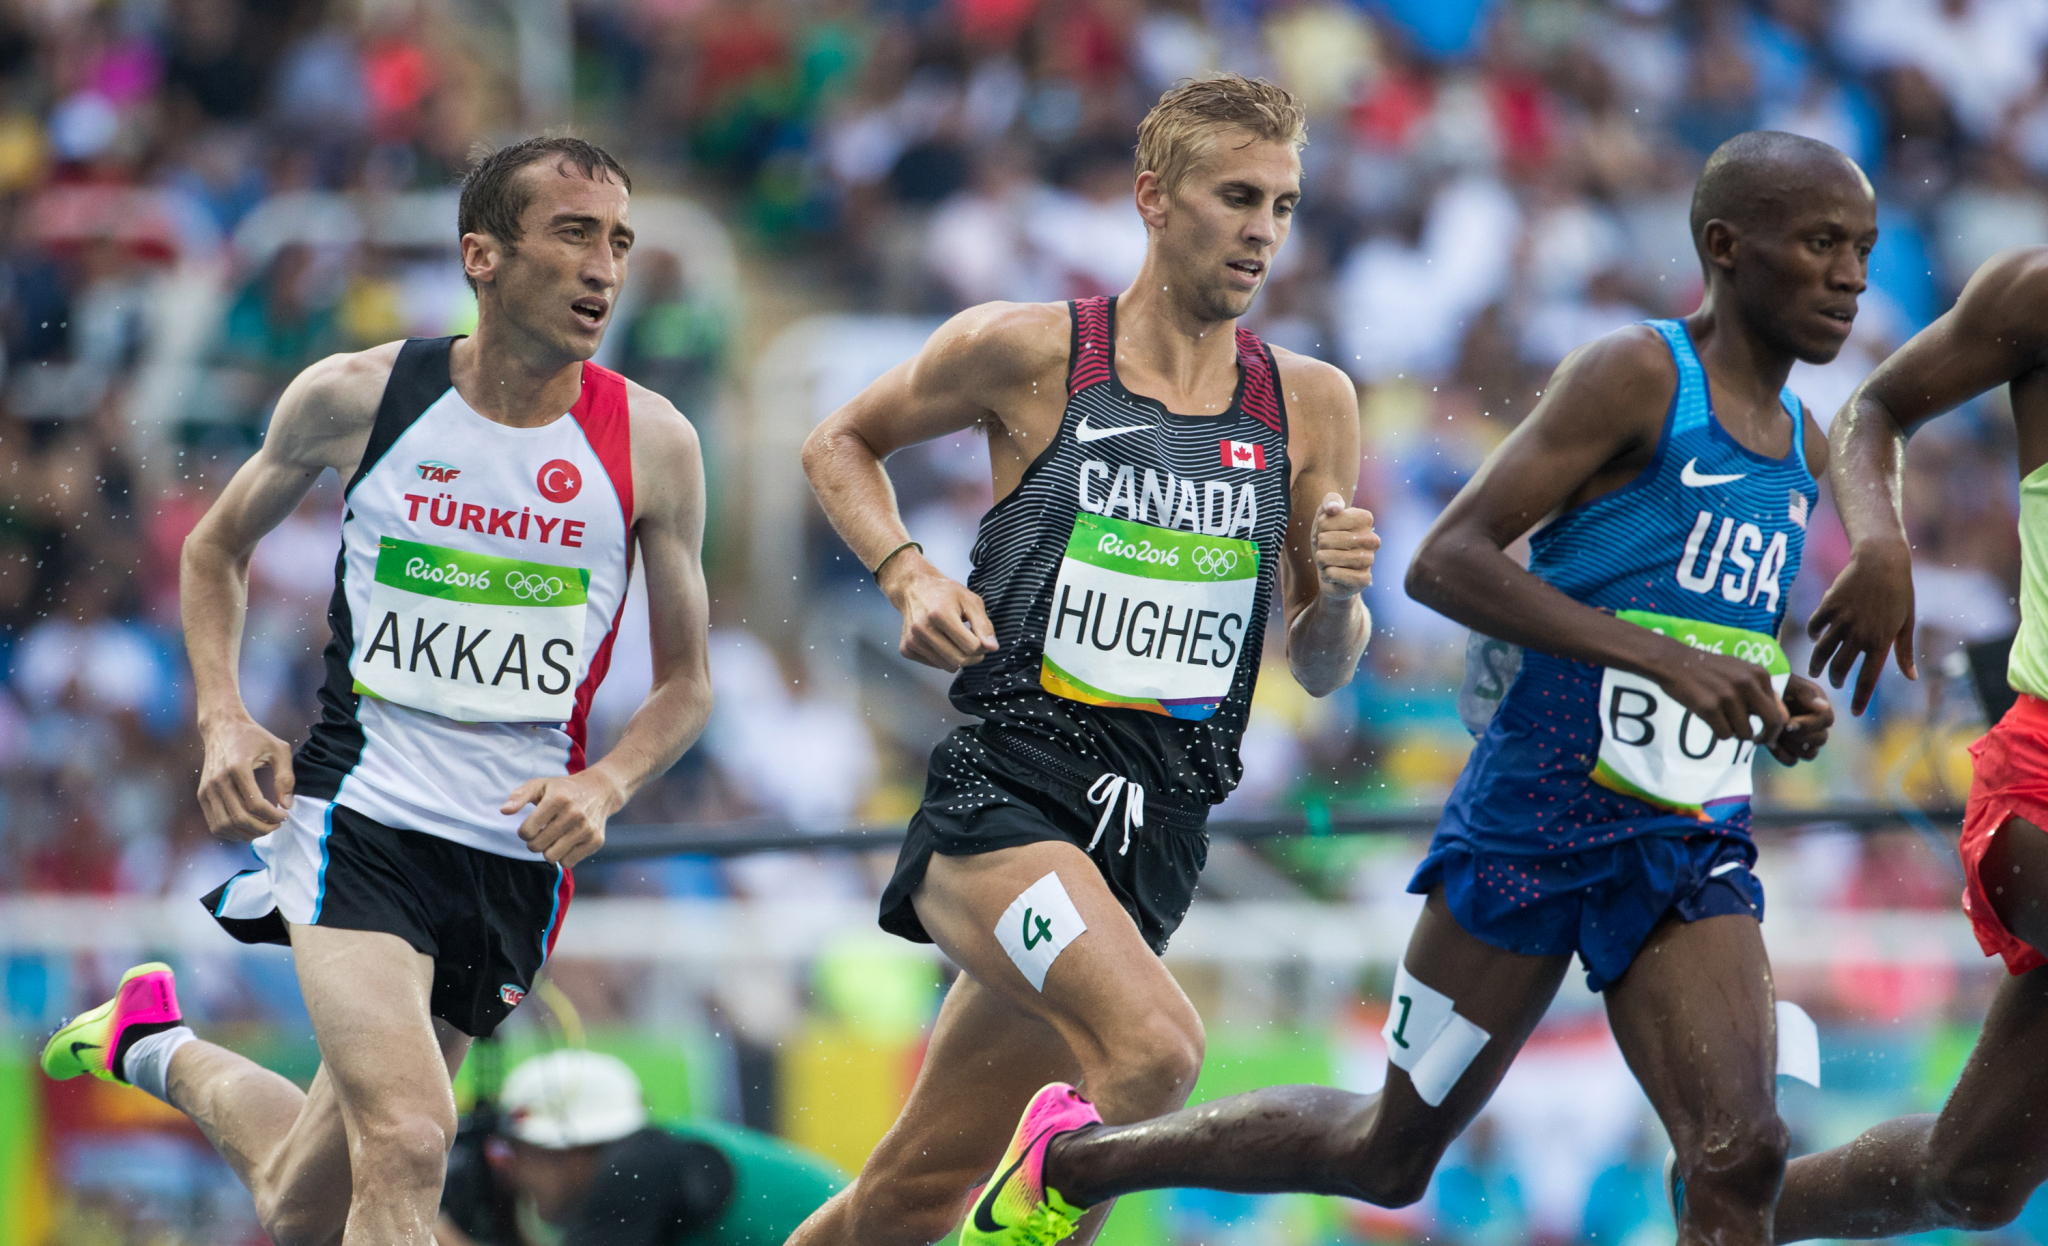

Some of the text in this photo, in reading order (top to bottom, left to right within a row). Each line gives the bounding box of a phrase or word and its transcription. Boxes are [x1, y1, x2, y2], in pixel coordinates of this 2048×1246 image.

[416, 464, 462, 484] TAF
[1078, 460, 1258, 541] CANADA
[403, 492, 587, 549] TÜRKİYE
[1675, 510, 1788, 614] USA
[362, 610, 575, 696] AKKAS
[1053, 583, 1243, 669] HUGHES
[1022, 906, 1053, 952] 4
[1391, 994, 1413, 1050] 1
